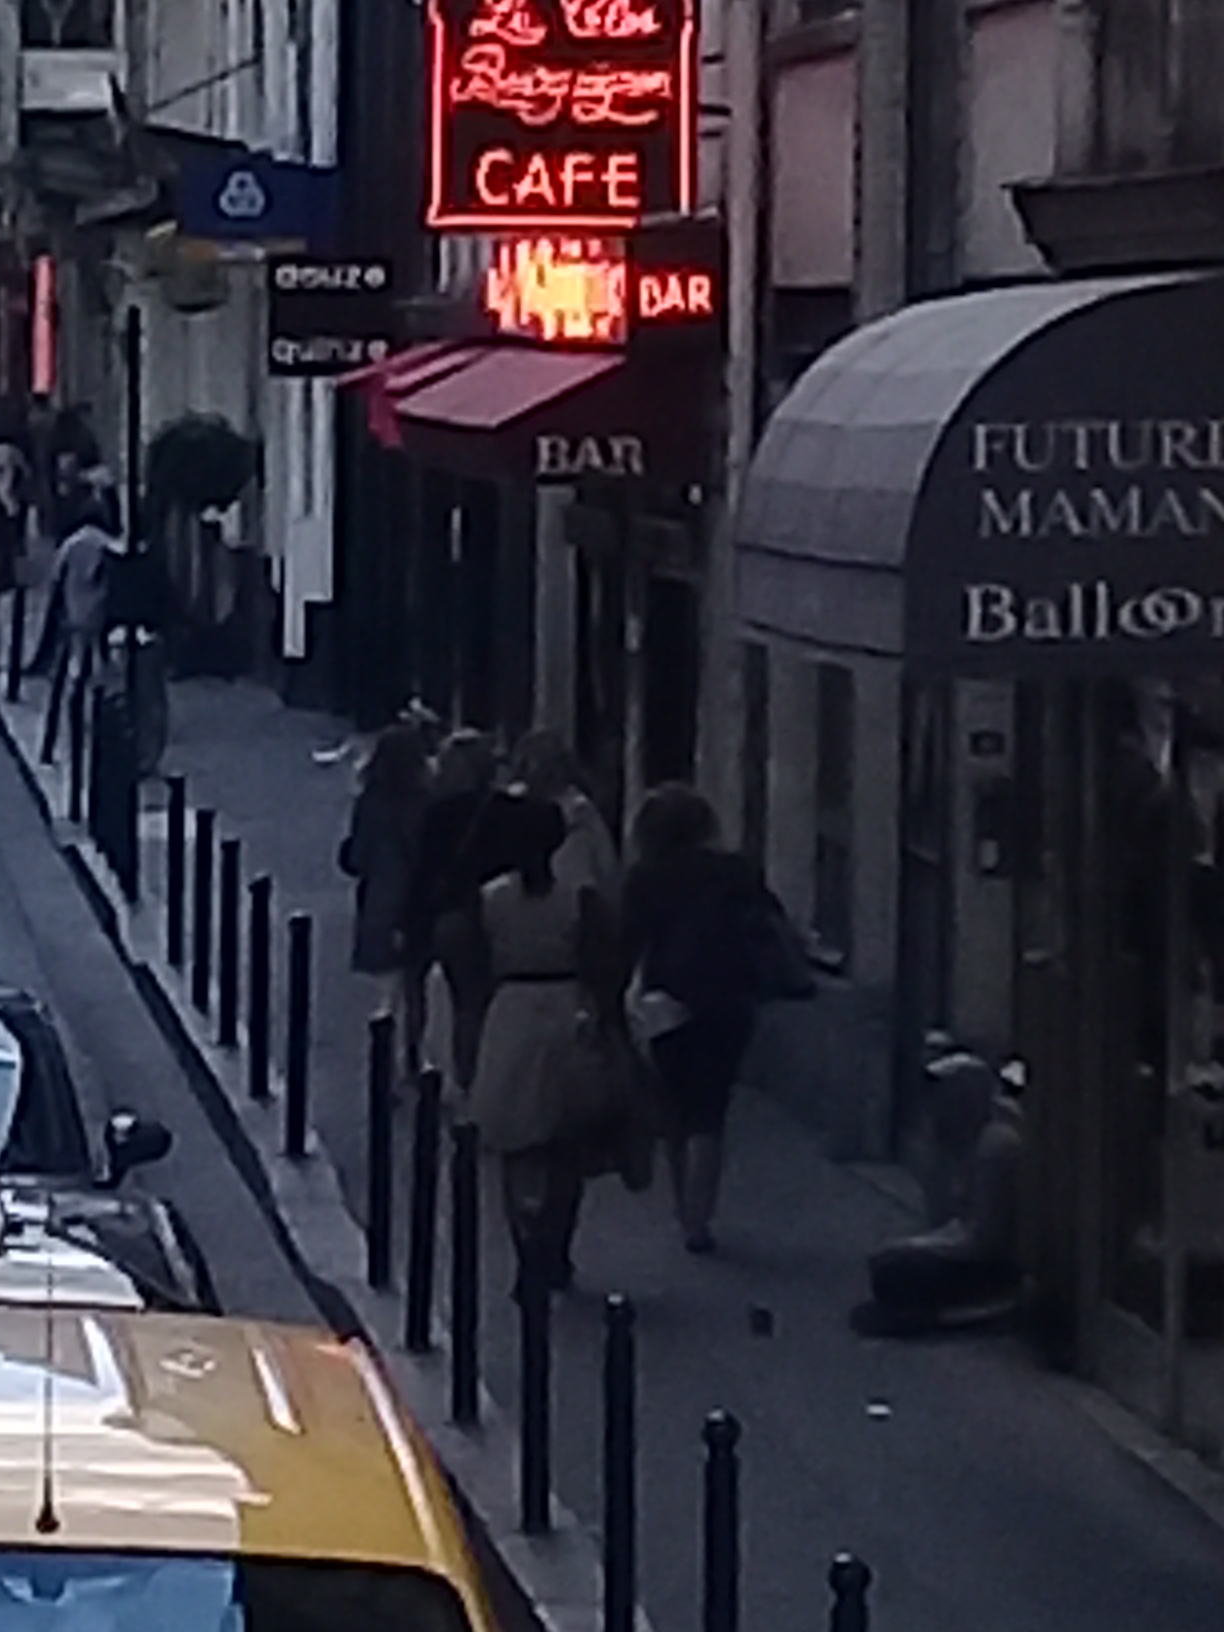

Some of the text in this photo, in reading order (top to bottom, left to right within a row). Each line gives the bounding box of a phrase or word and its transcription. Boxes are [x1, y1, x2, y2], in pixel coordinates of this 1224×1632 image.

[476, 148, 640, 207] CAFE
[639, 272, 713, 318] BAR
[535, 433, 645, 476] BAR
